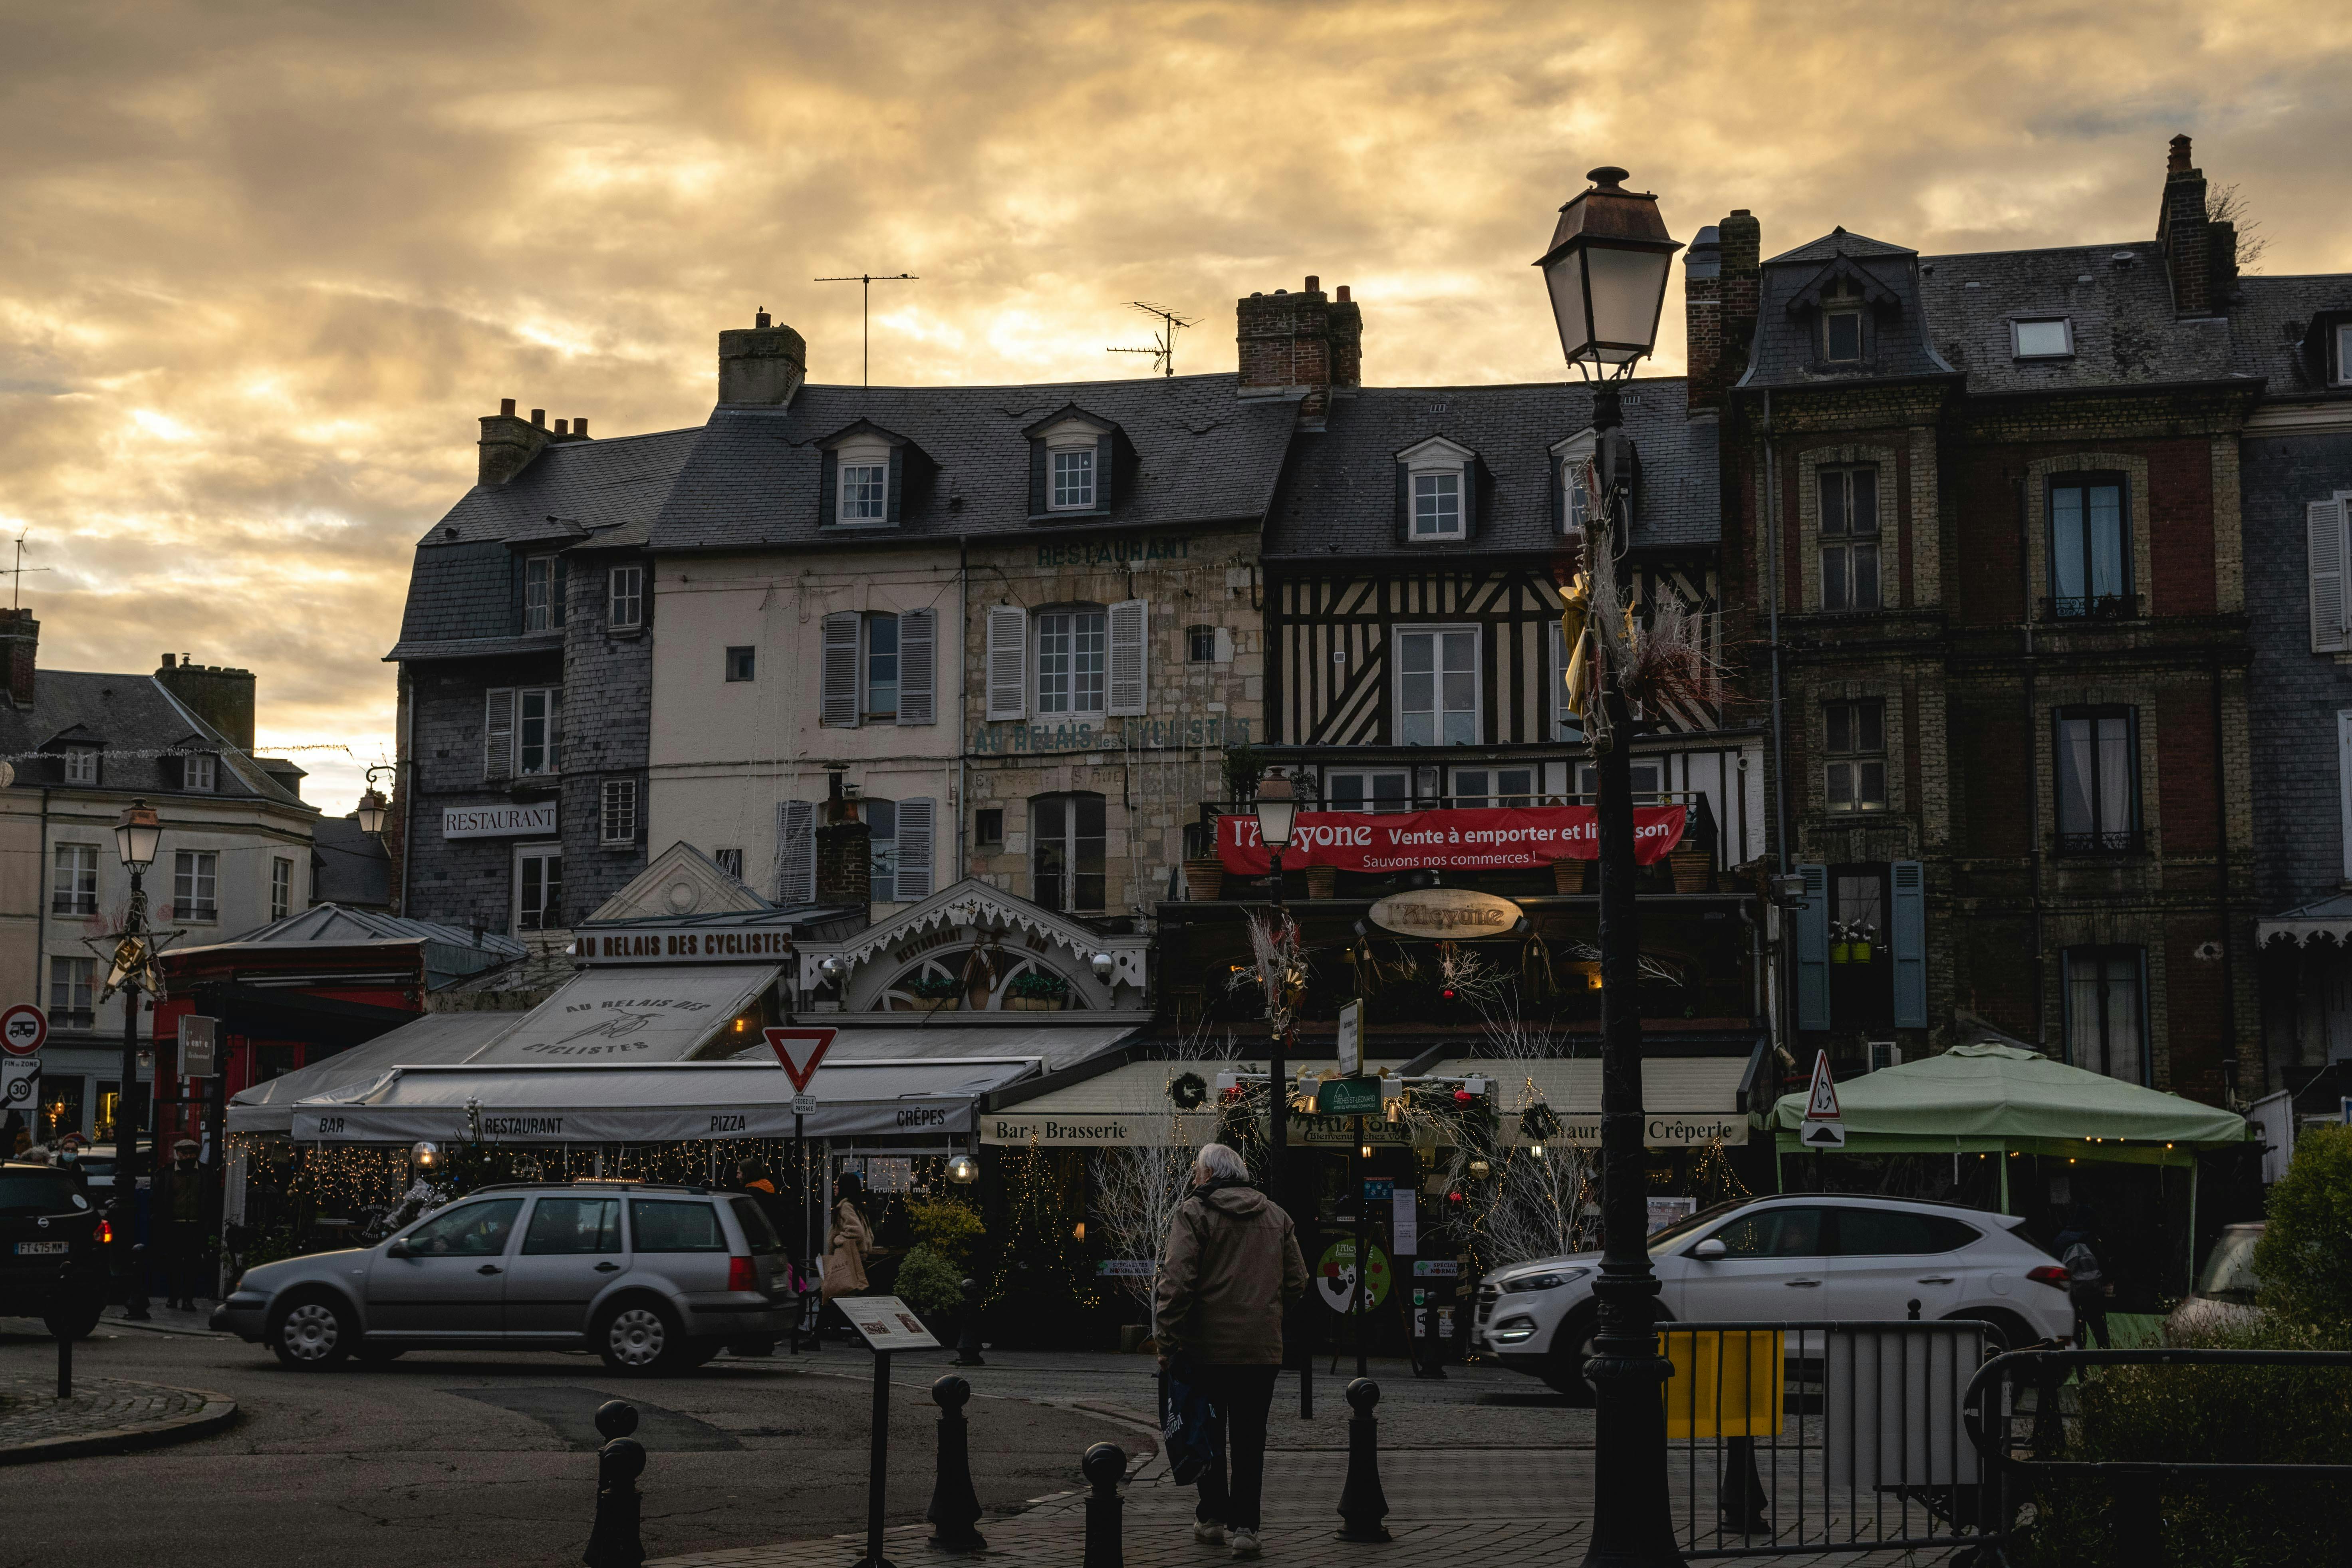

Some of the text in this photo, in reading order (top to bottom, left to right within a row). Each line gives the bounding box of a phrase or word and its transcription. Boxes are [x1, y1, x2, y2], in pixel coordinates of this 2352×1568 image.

[1038, 537, 1191, 565] RESTAURANT
[975, 727, 1002, 752] AU
[1015, 723, 1091, 751] RELAIS
[446, 809, 554, 831] RESTAURANT
[1233, 821, 1669, 852] l'yone Vente à emporter et lison
[1363, 855, 1419, 868] Sauvons
[1424, 856, 1447, 866] nos
[1451, 852, 1529, 865] commerces
[1387, 905, 1504, 929] l'Alcyone
[575, 933, 793, 957] AU RELAIS DES CYCLISTES
[894, 927, 1049, 964] RESTAURANT BAR
[566, 999, 711, 1013] AU RELAIS DES
[522, 1041, 649, 1054] CYCLISTES
[12, 1085, 27, 1095] 30
[1333, 1094, 1375, 1104] ARCHES ST-LÉONARD
[319, 1117, 345, 1133] BAR
[485, 1117, 563, 1134] RESTAURANT
[711, 1115, 746, 1132] PIZZA
[897, 1107, 945, 1127] CRÊPES
[996, 1121, 1127, 1138] Bar Brasserie
[1364, 1131, 1385, 1140] chez
[1649, 1121, 1732, 1143] Crêperie
